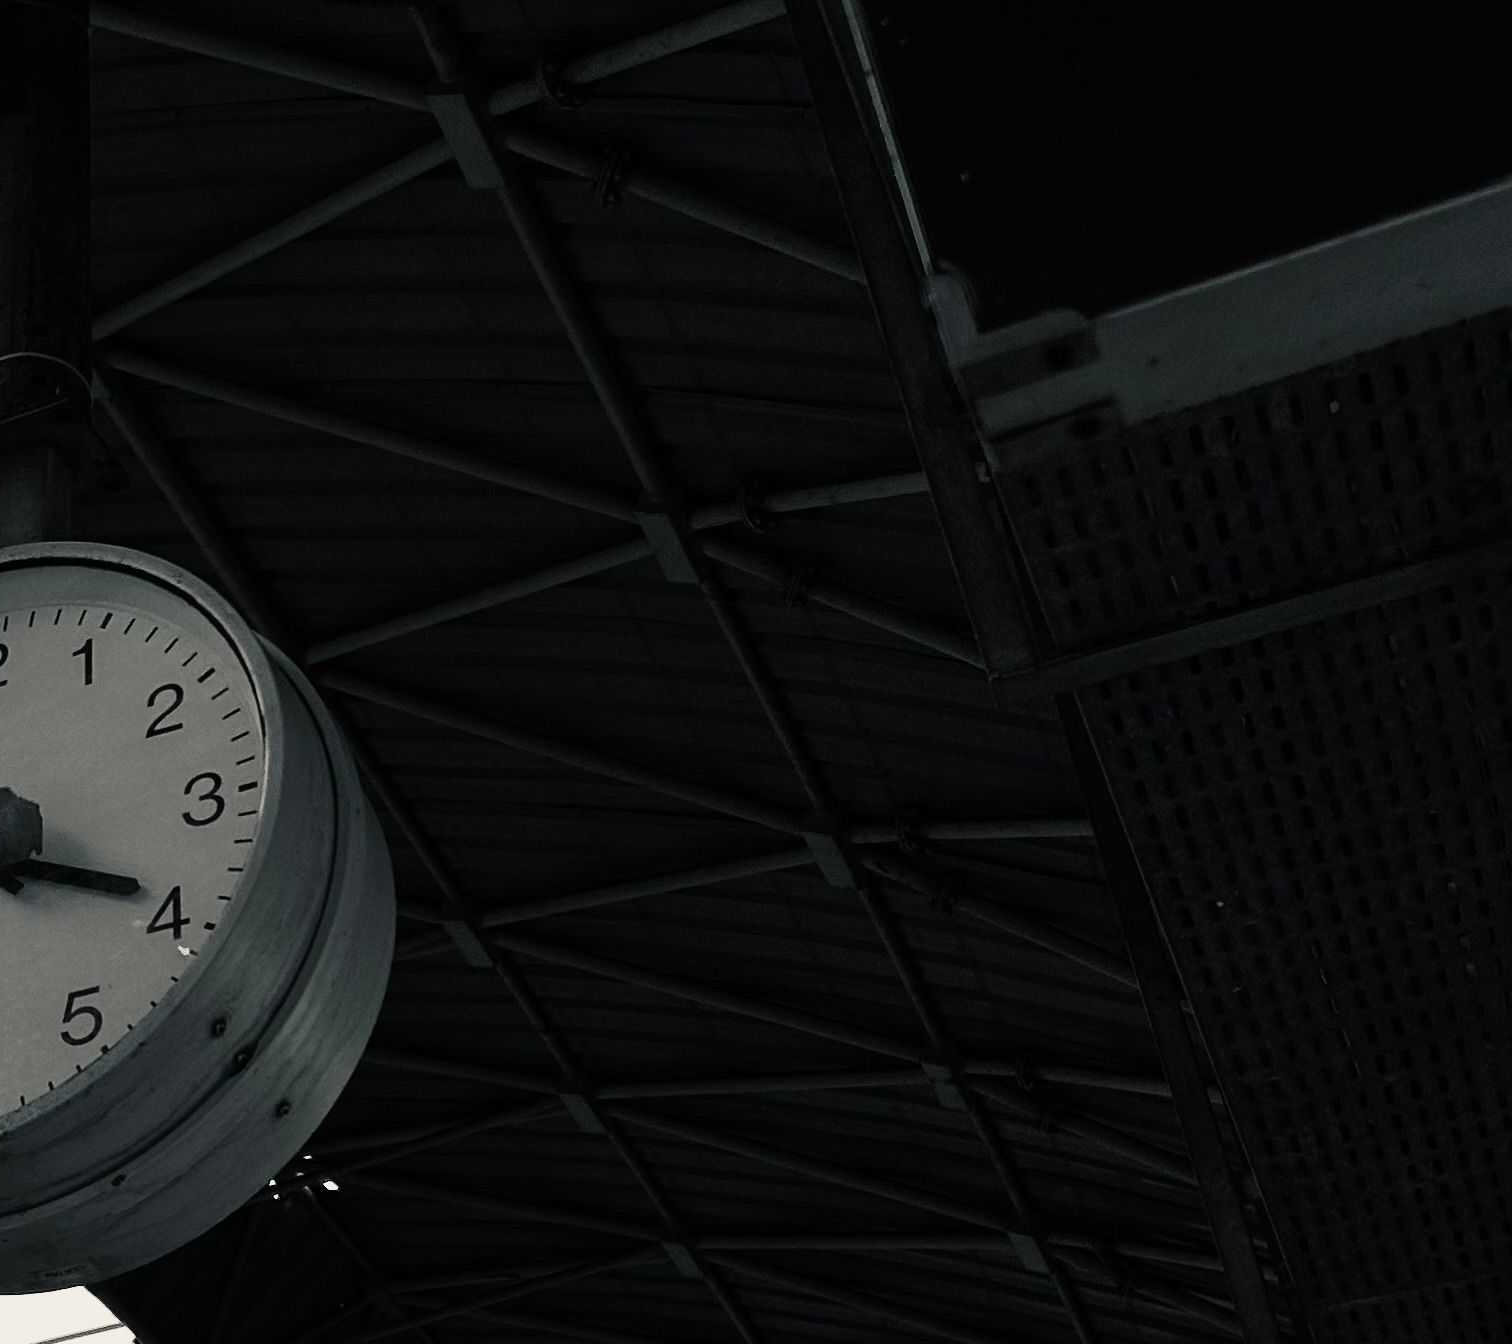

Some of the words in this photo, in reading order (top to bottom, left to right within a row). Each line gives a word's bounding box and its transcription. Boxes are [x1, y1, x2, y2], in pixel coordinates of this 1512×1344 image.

[72, 638, 94, 685] 1
[146, 683, 185, 738] 2
[182, 772, 226, 826] 3
[146, 885, 191, 940] 4
[60, 985, 103, 1046] 5
